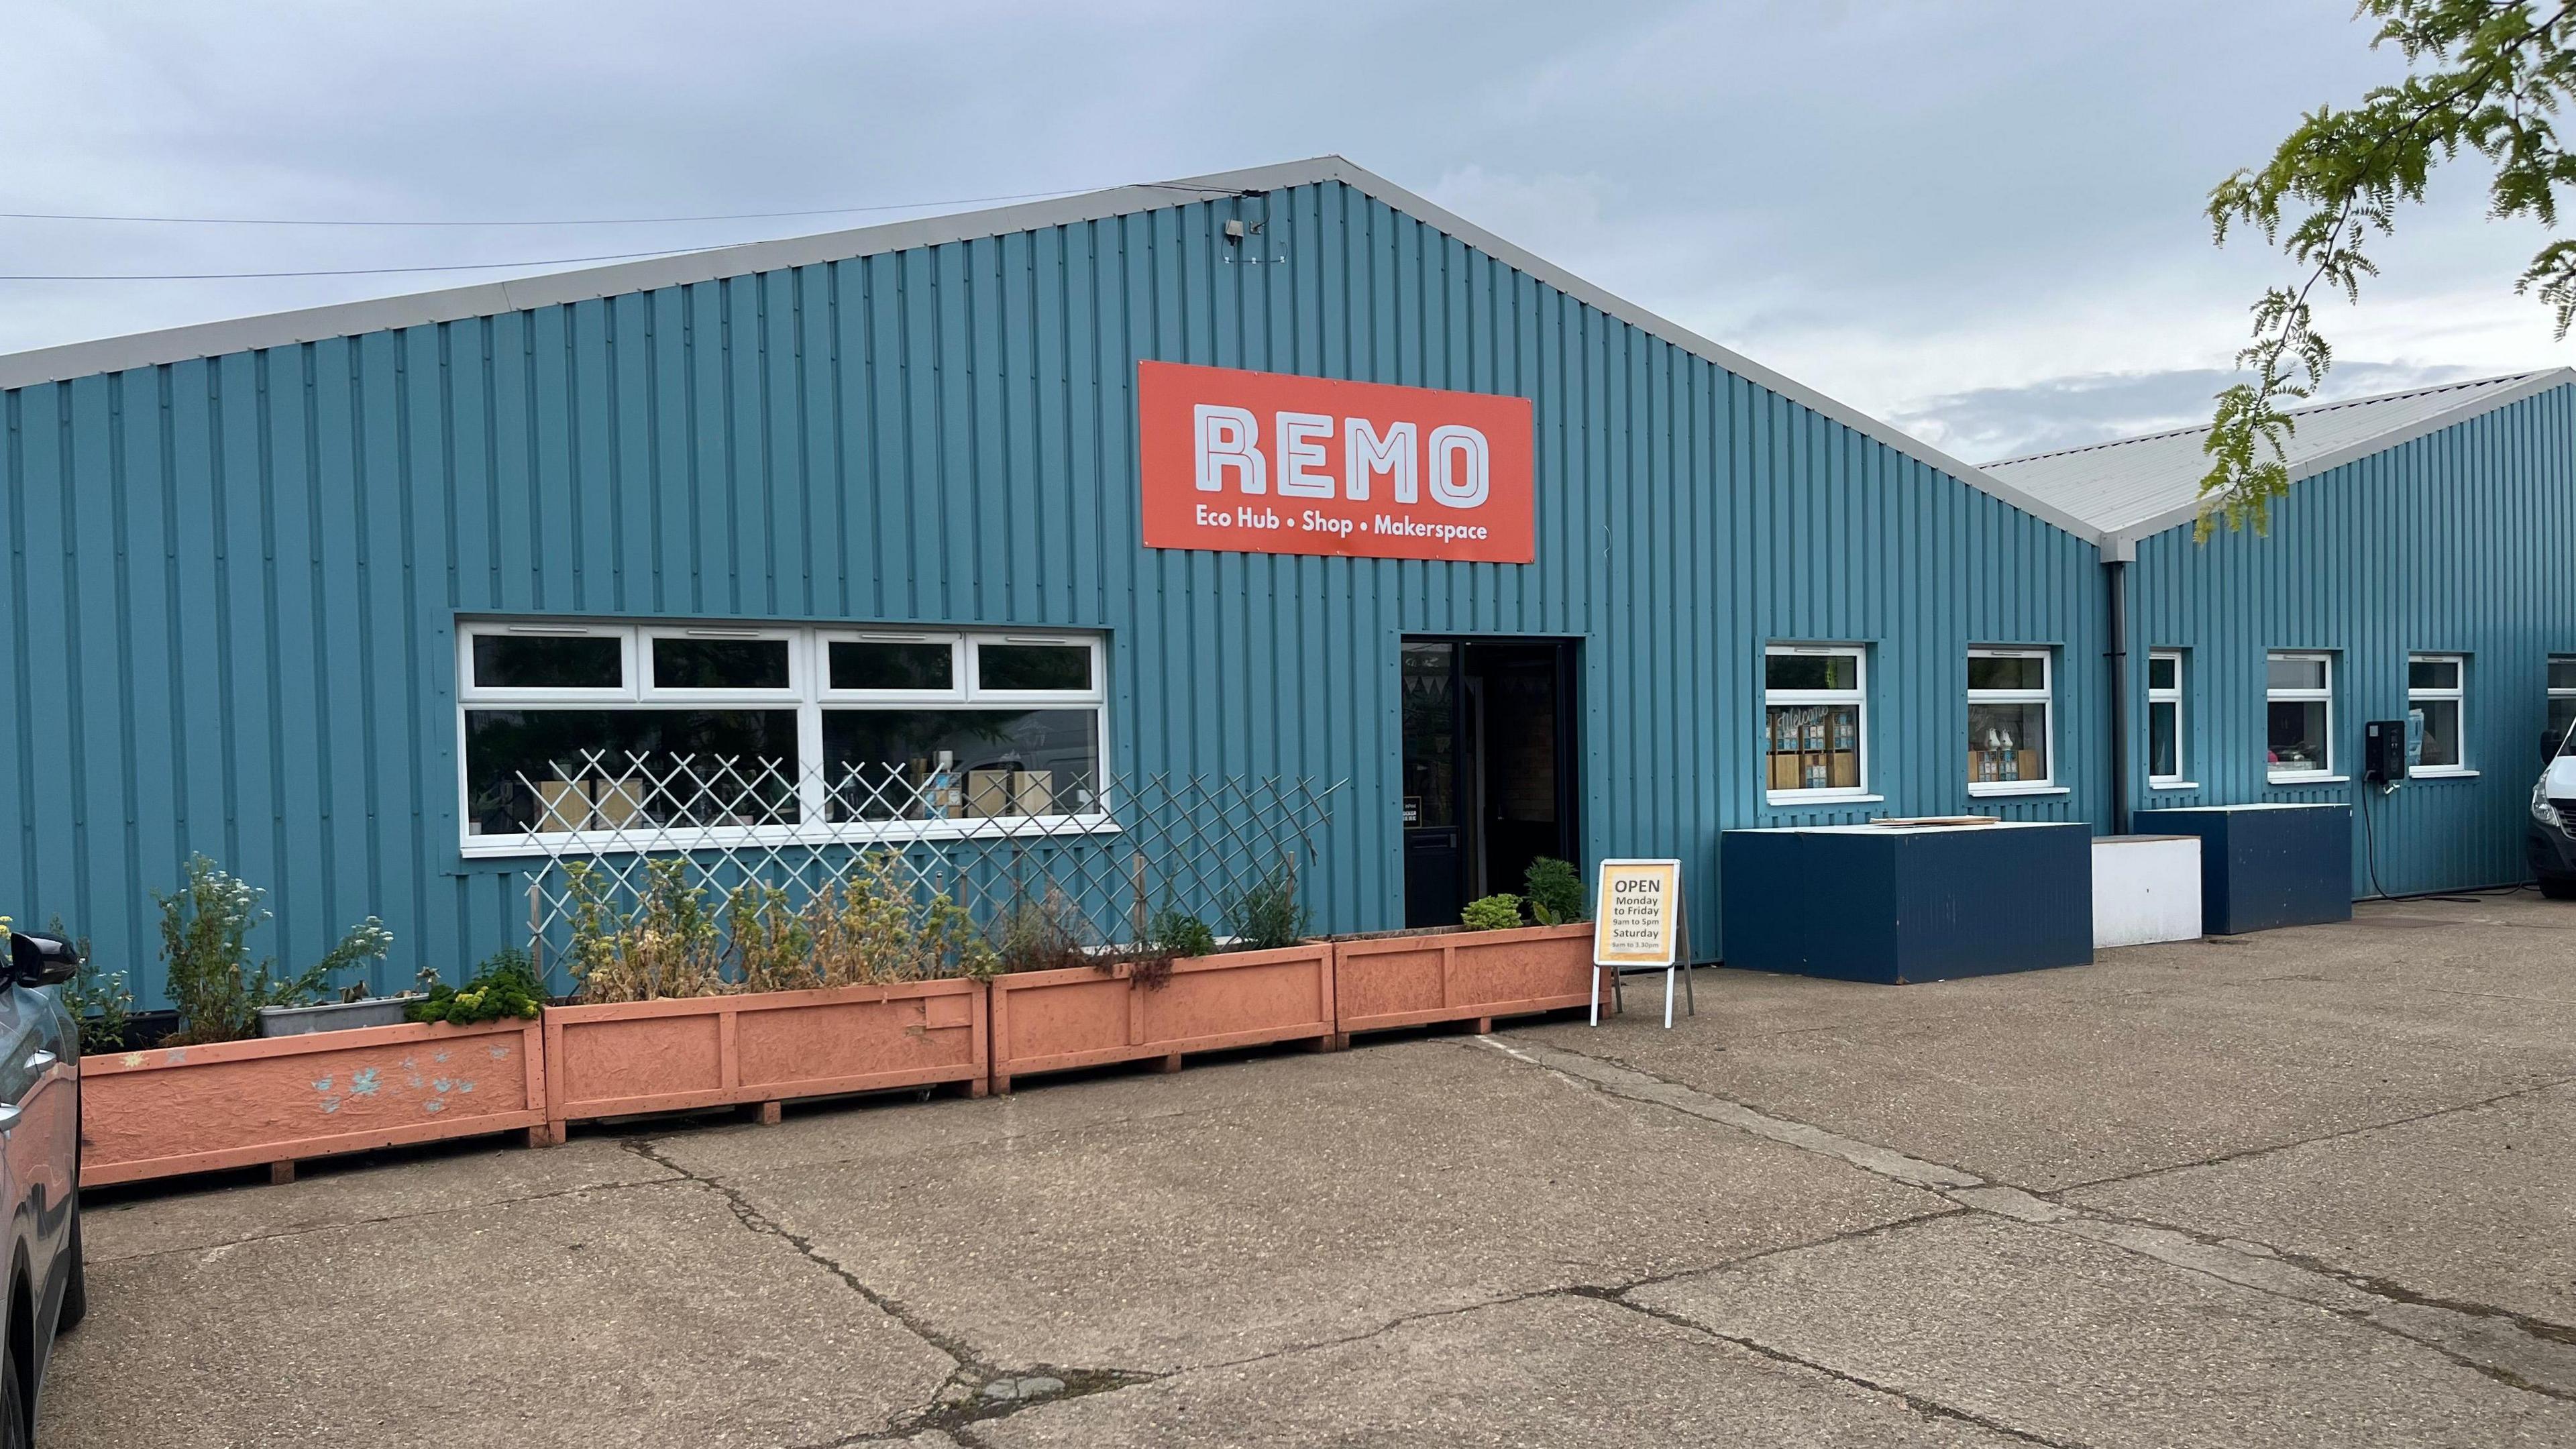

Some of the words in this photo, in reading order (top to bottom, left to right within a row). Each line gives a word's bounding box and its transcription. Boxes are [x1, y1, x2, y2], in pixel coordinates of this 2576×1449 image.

[1193, 403, 1489, 509] REMO
[1196, 504, 1232, 527] Eco
[1238, 506, 1280, 530] Hub
[1302, 511, 1353, 538] Shop
[1375, 515, 1488, 543] Makerspace
[1778, 705, 1829, 733] Welcome
[1615, 879, 1660, 893] OPEN
[1616, 896, 1658, 906] Monday
[1627, 906, 1659, 916] Friday
[1613, 928, 1659, 939] Saturday
